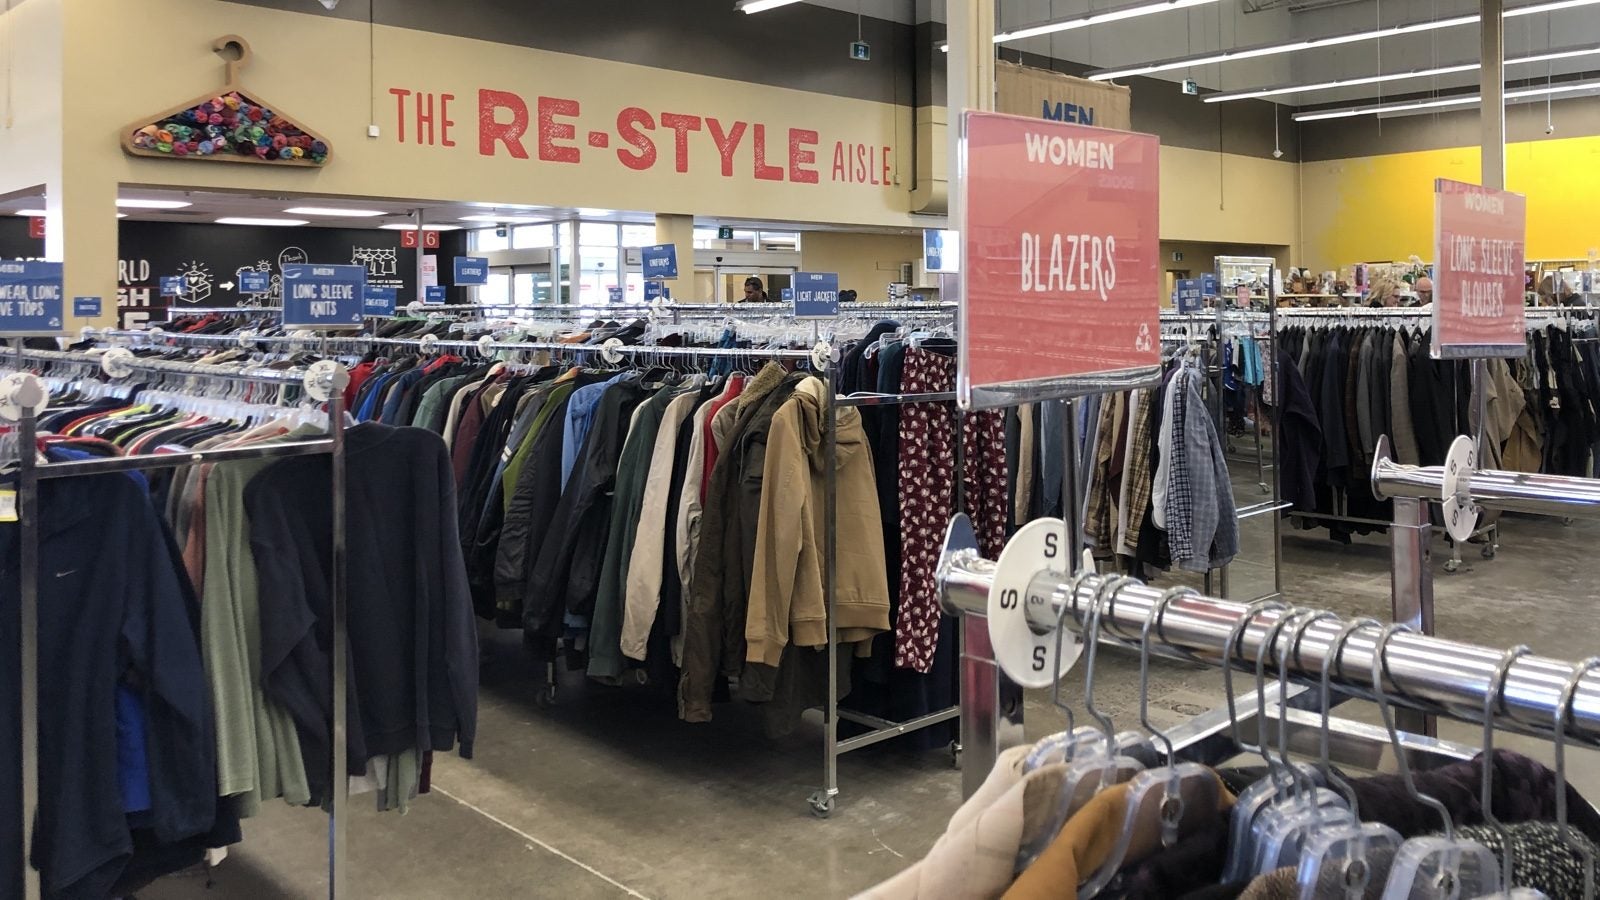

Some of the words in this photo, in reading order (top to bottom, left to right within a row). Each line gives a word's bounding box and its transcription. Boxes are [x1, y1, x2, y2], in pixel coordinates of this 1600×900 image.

[1042, 98, 1095, 126] MEN
[389, 88, 456, 148] THE
[478, 88, 819, 184] RE-STYLE
[831, 140, 892, 185] AISLE
[1024, 132, 1114, 170] WOMEN
[1464, 192, 1504, 215] WOMEN
[406, 231, 415, 246] 5
[426, 231, 436, 246] 6
[1020, 232, 1116, 301] BLAZERS
[1450, 234, 1476, 273] LONG
[1481, 238, 1515, 276] SLEEVE
[118, 260, 150, 285] RLD
[0, 285, 30, 302] WEAR
[33, 285, 61, 300] LONG
[293, 284, 318, 299] LONG
[320, 284, 354, 299] SLEEVE
[796, 291, 811, 302] LIGHT
[813, 291, 836, 304] JACKETS
[1461, 280, 1505, 317] BLOUSES
[0, 301, 13, 316] VE
[17, 301, 44, 316] TOPS
[310, 301, 337, 318] KNITS
[1044, 532, 1058, 558] S
[1000, 588, 1017, 610] S
[1032, 645, 1046, 671] S
